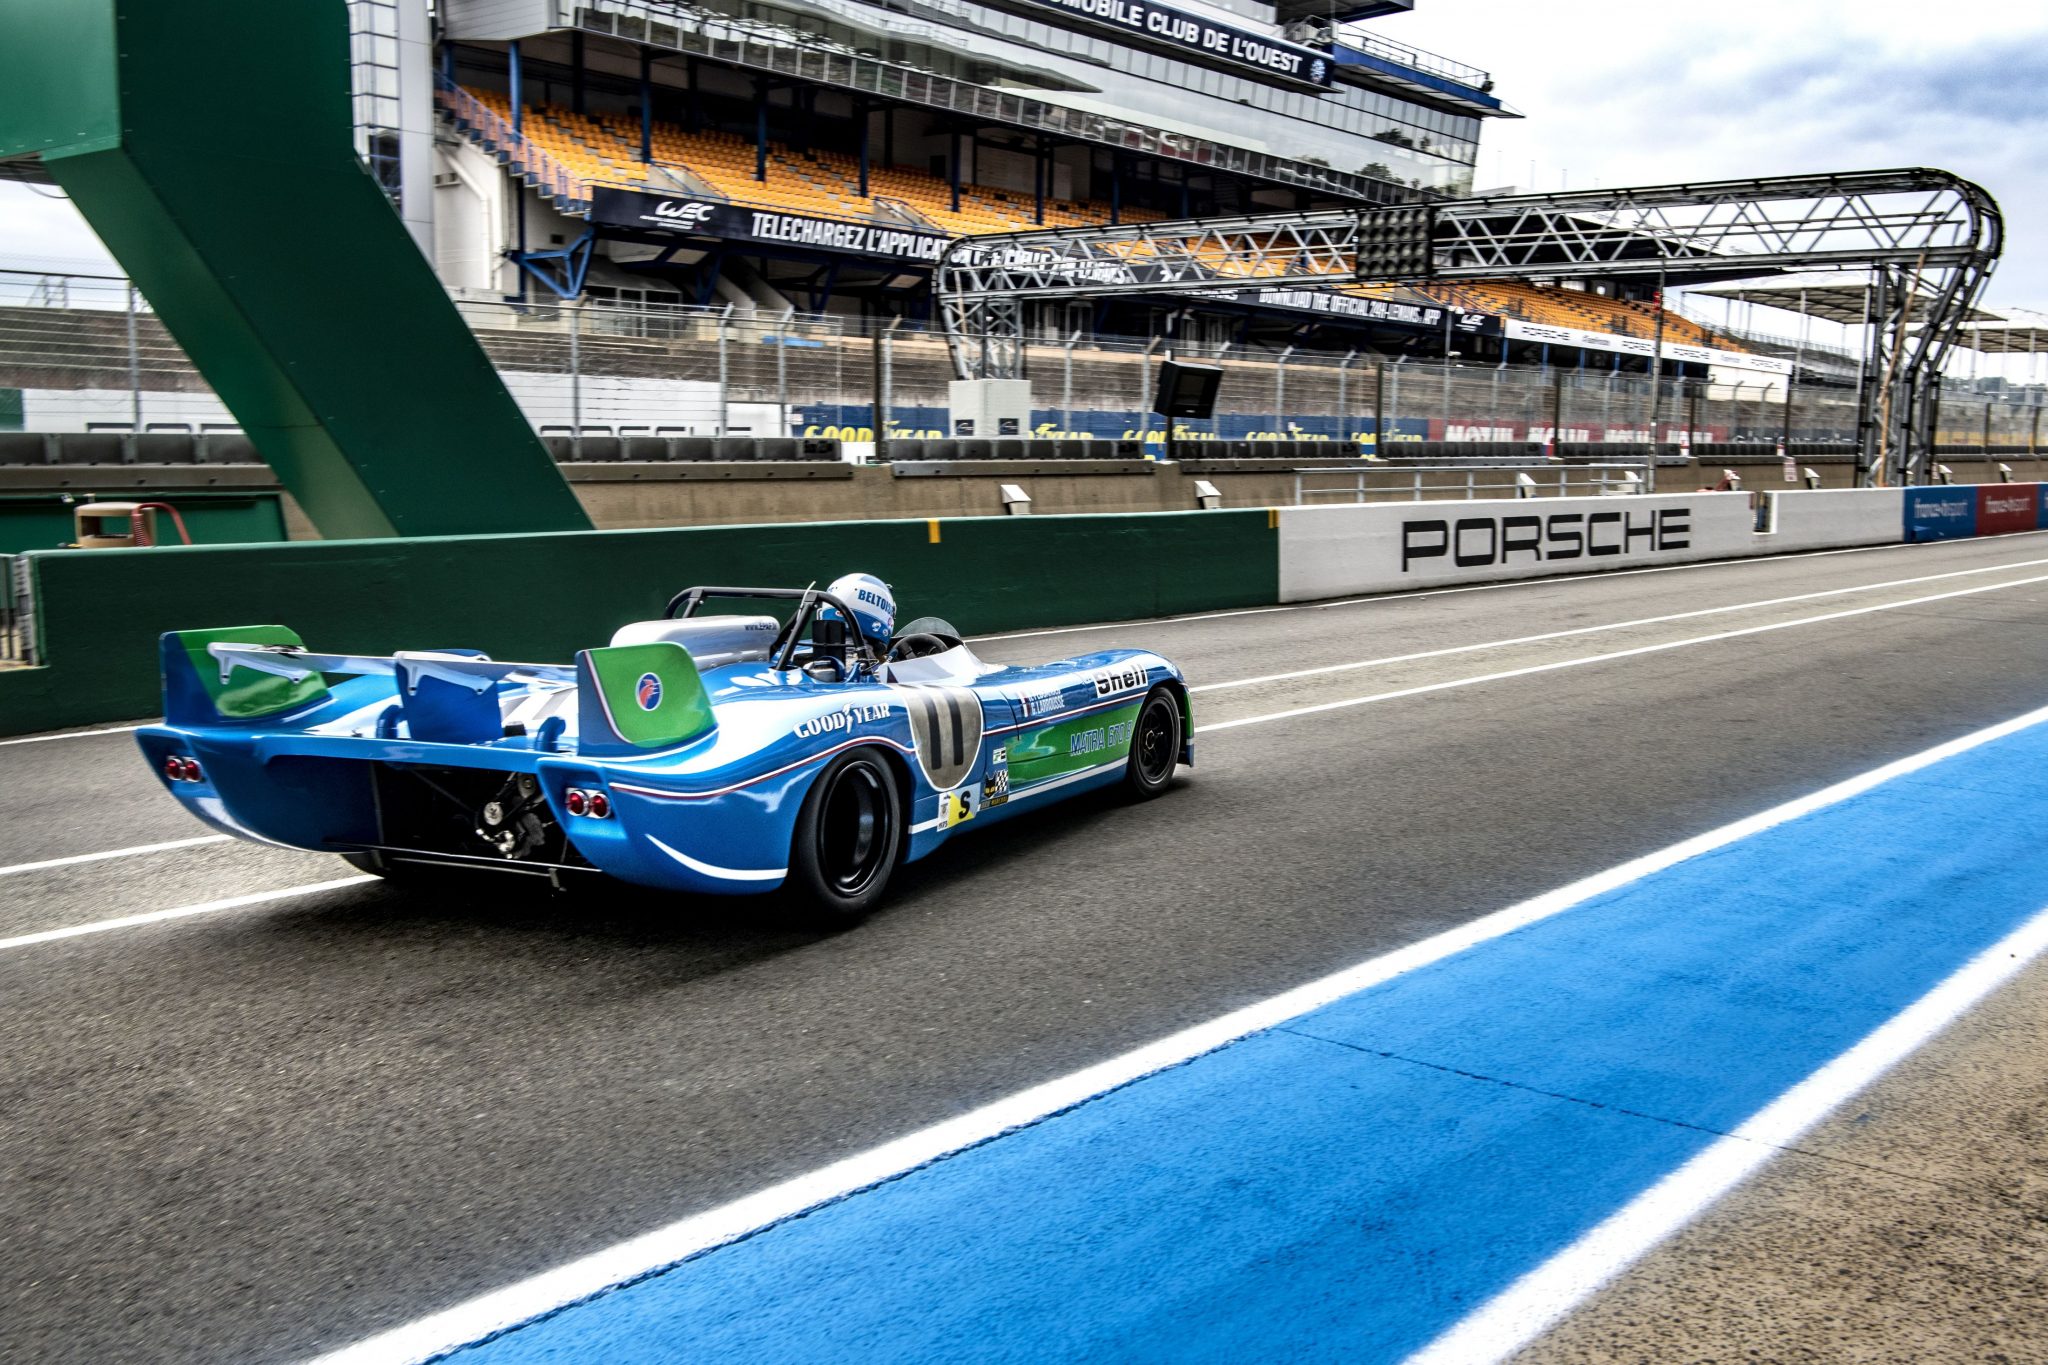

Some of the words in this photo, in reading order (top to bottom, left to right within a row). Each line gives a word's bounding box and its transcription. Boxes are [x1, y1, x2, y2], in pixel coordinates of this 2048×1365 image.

[1050, 0, 1144, 26] OBILE
[1147, 12, 1199, 43] CLUB
[1202, 28, 1230, 52] DE
[1232, 37, 1303, 73] L'OUEST
[655, 201, 715, 221] WEC
[752, 212, 866, 250] TELECHARGEZ
[1621, 340, 1657, 352] PORSC
[1401, 508, 1690, 572] PORSCHE
[1093, 664, 1147, 694] Shell
[1070, 727, 1105, 756] MATRA
[958, 790, 971, 819] S
